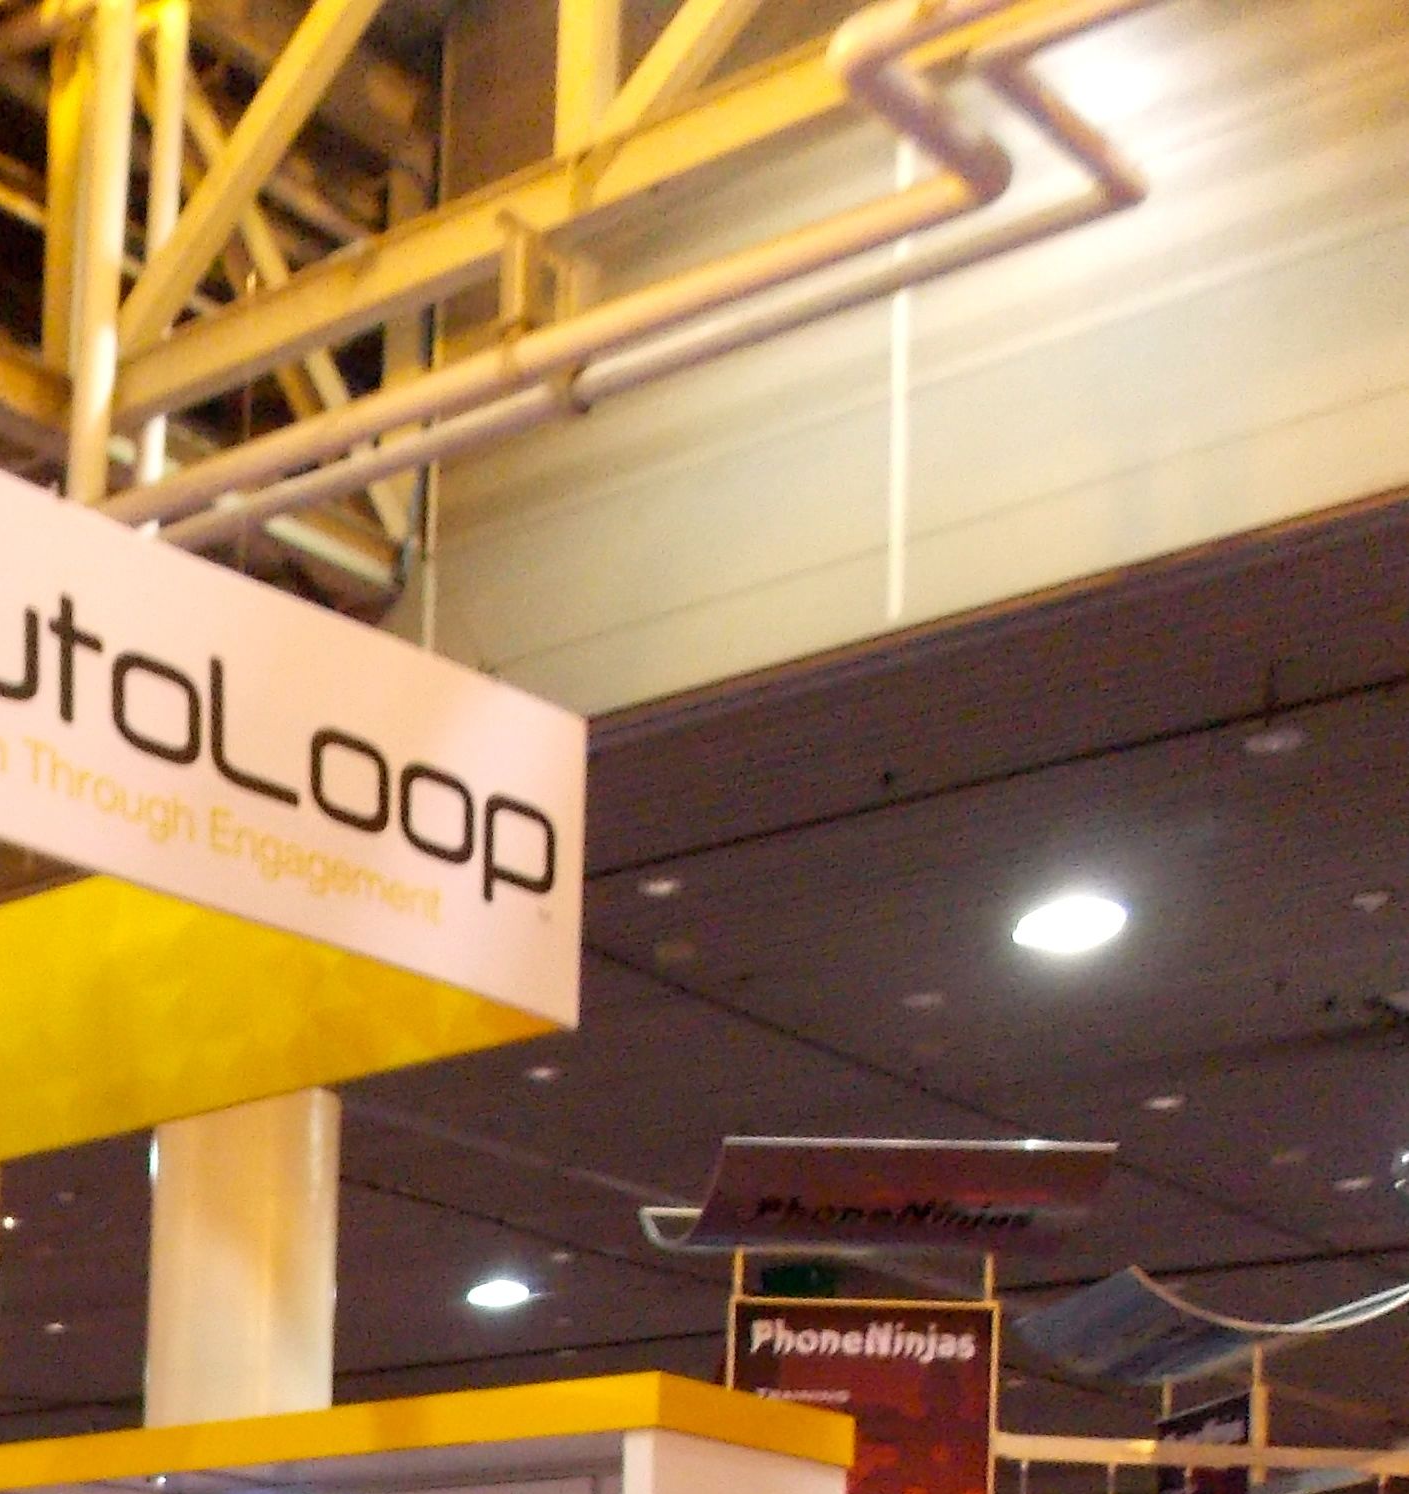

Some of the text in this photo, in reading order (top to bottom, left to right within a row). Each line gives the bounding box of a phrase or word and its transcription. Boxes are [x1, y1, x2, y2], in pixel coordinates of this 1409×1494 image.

[21, 736, 197, 845] Through
[208, 803, 442, 926] Engagement
[750, 1318, 977, 1365] PhoneNinjas
